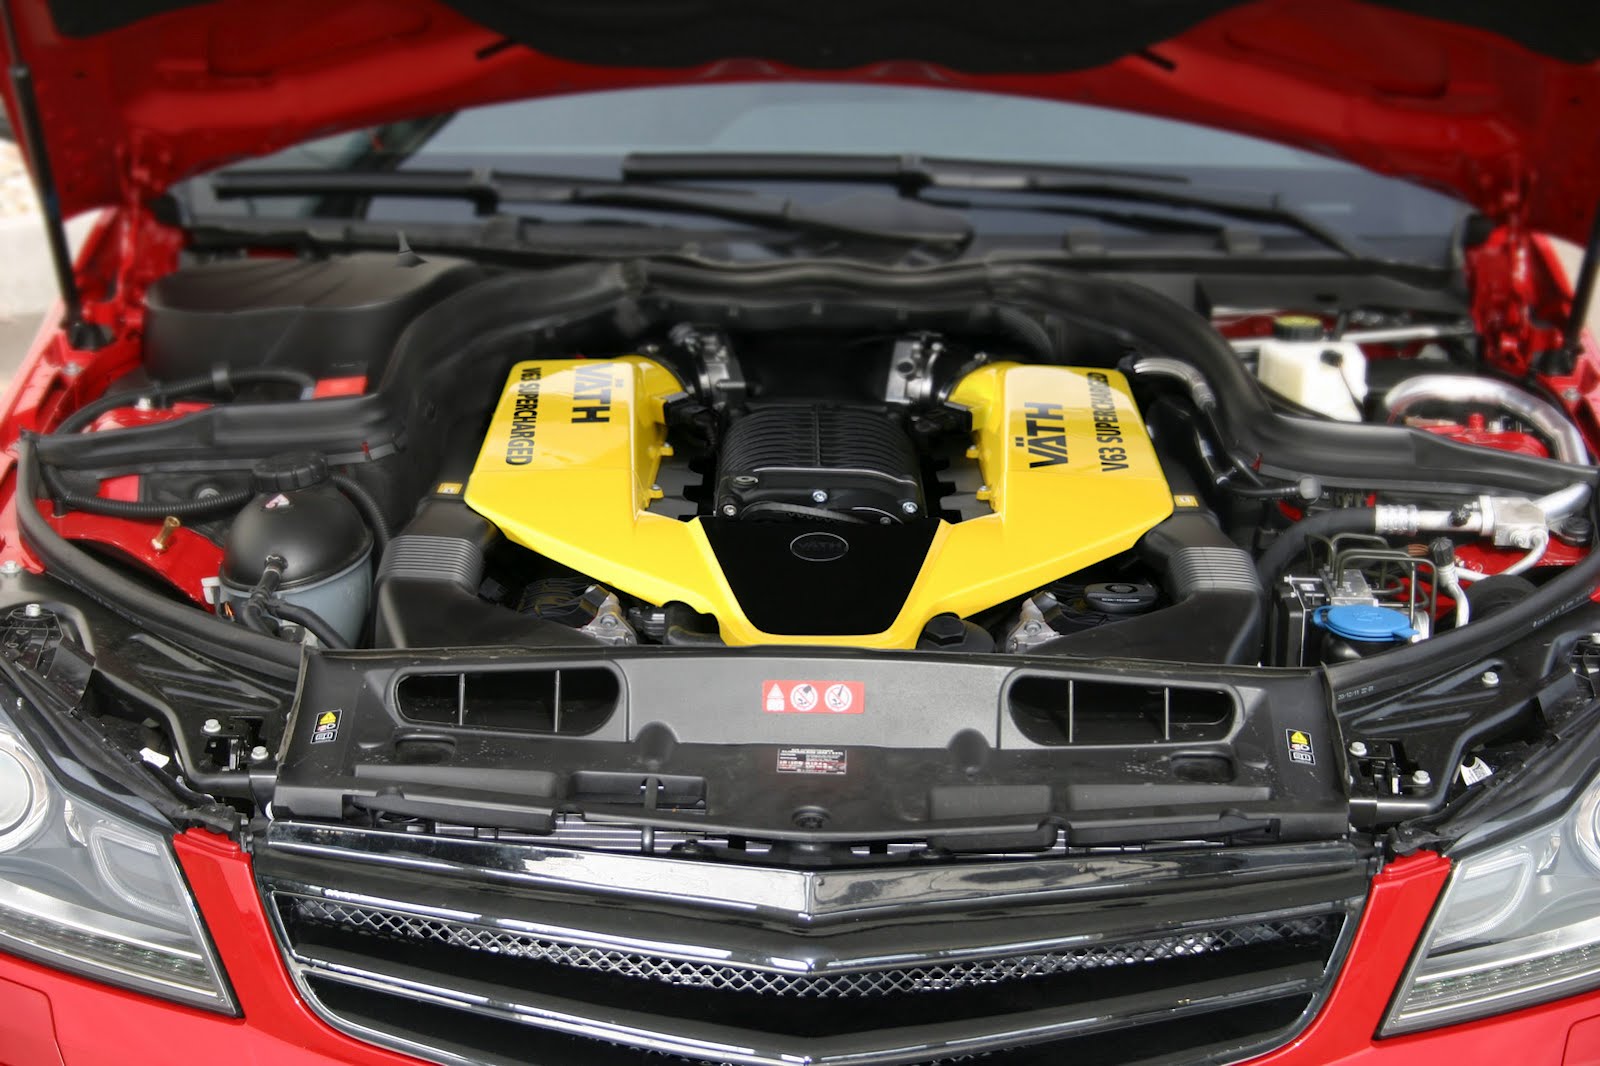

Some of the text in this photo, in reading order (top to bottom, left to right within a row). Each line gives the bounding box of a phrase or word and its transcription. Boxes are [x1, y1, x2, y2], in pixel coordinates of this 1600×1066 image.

[506, 367, 542, 466] V63 SUPERCHARGED
[571, 362, 624, 424] VÄTH
[1088, 372, 1129, 472] V63 SUPERCHARGED
[1015, 402, 1069, 469] VÄTH
